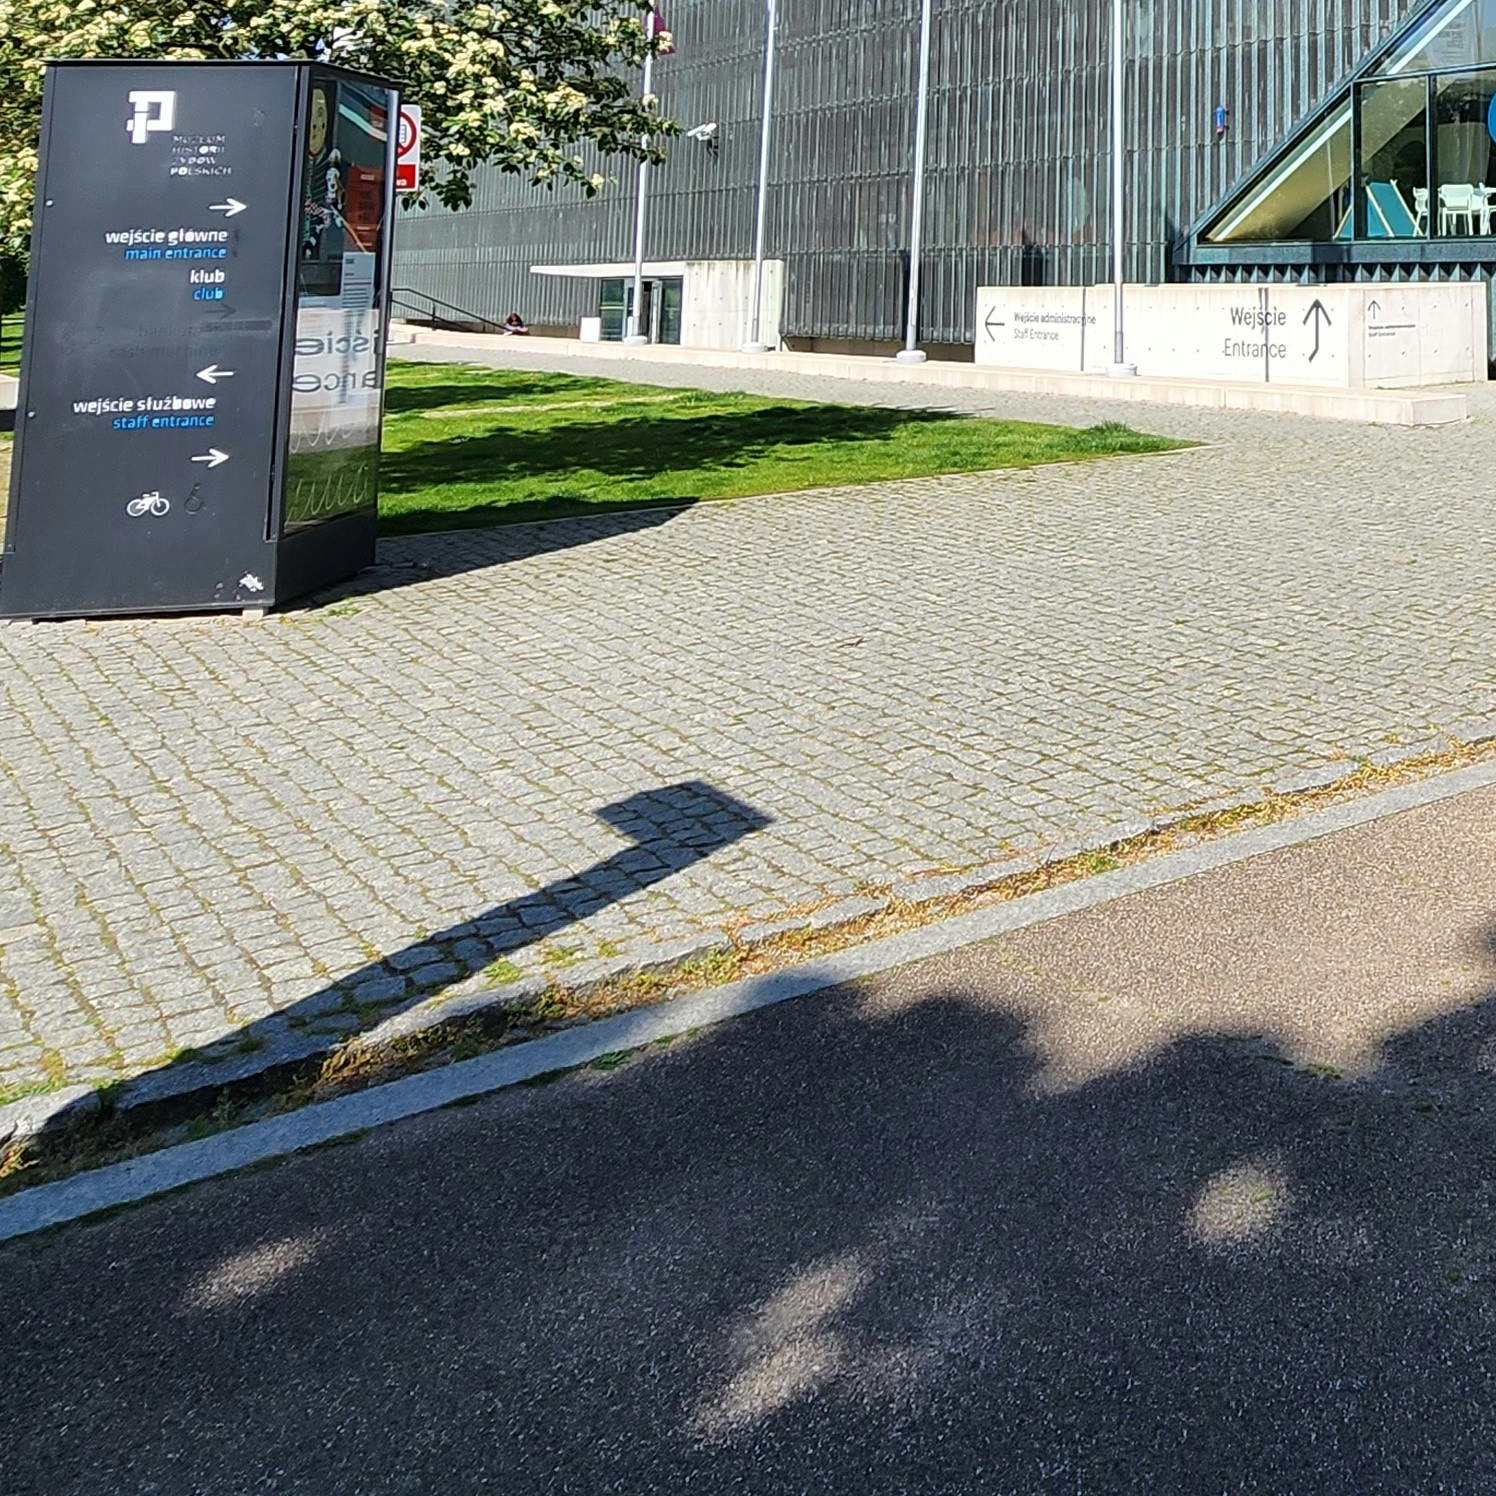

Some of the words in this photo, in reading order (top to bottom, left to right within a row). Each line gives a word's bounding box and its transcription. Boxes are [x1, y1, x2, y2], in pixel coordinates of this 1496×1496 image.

[105, 228, 165, 246] wejście
[167, 228, 228, 246] główne
[124, 247, 161, 259] main
[165, 247, 227, 259] entrance
[190, 268, 226, 284] klub
[193, 287, 224, 300] club
[1230, 305, 1286, 330] Wejście
[1224, 337, 1287, 358] Entrance
[73, 397, 133, 415] wejście
[112, 415, 149, 429] staff
[151, 415, 215, 428] entrance
